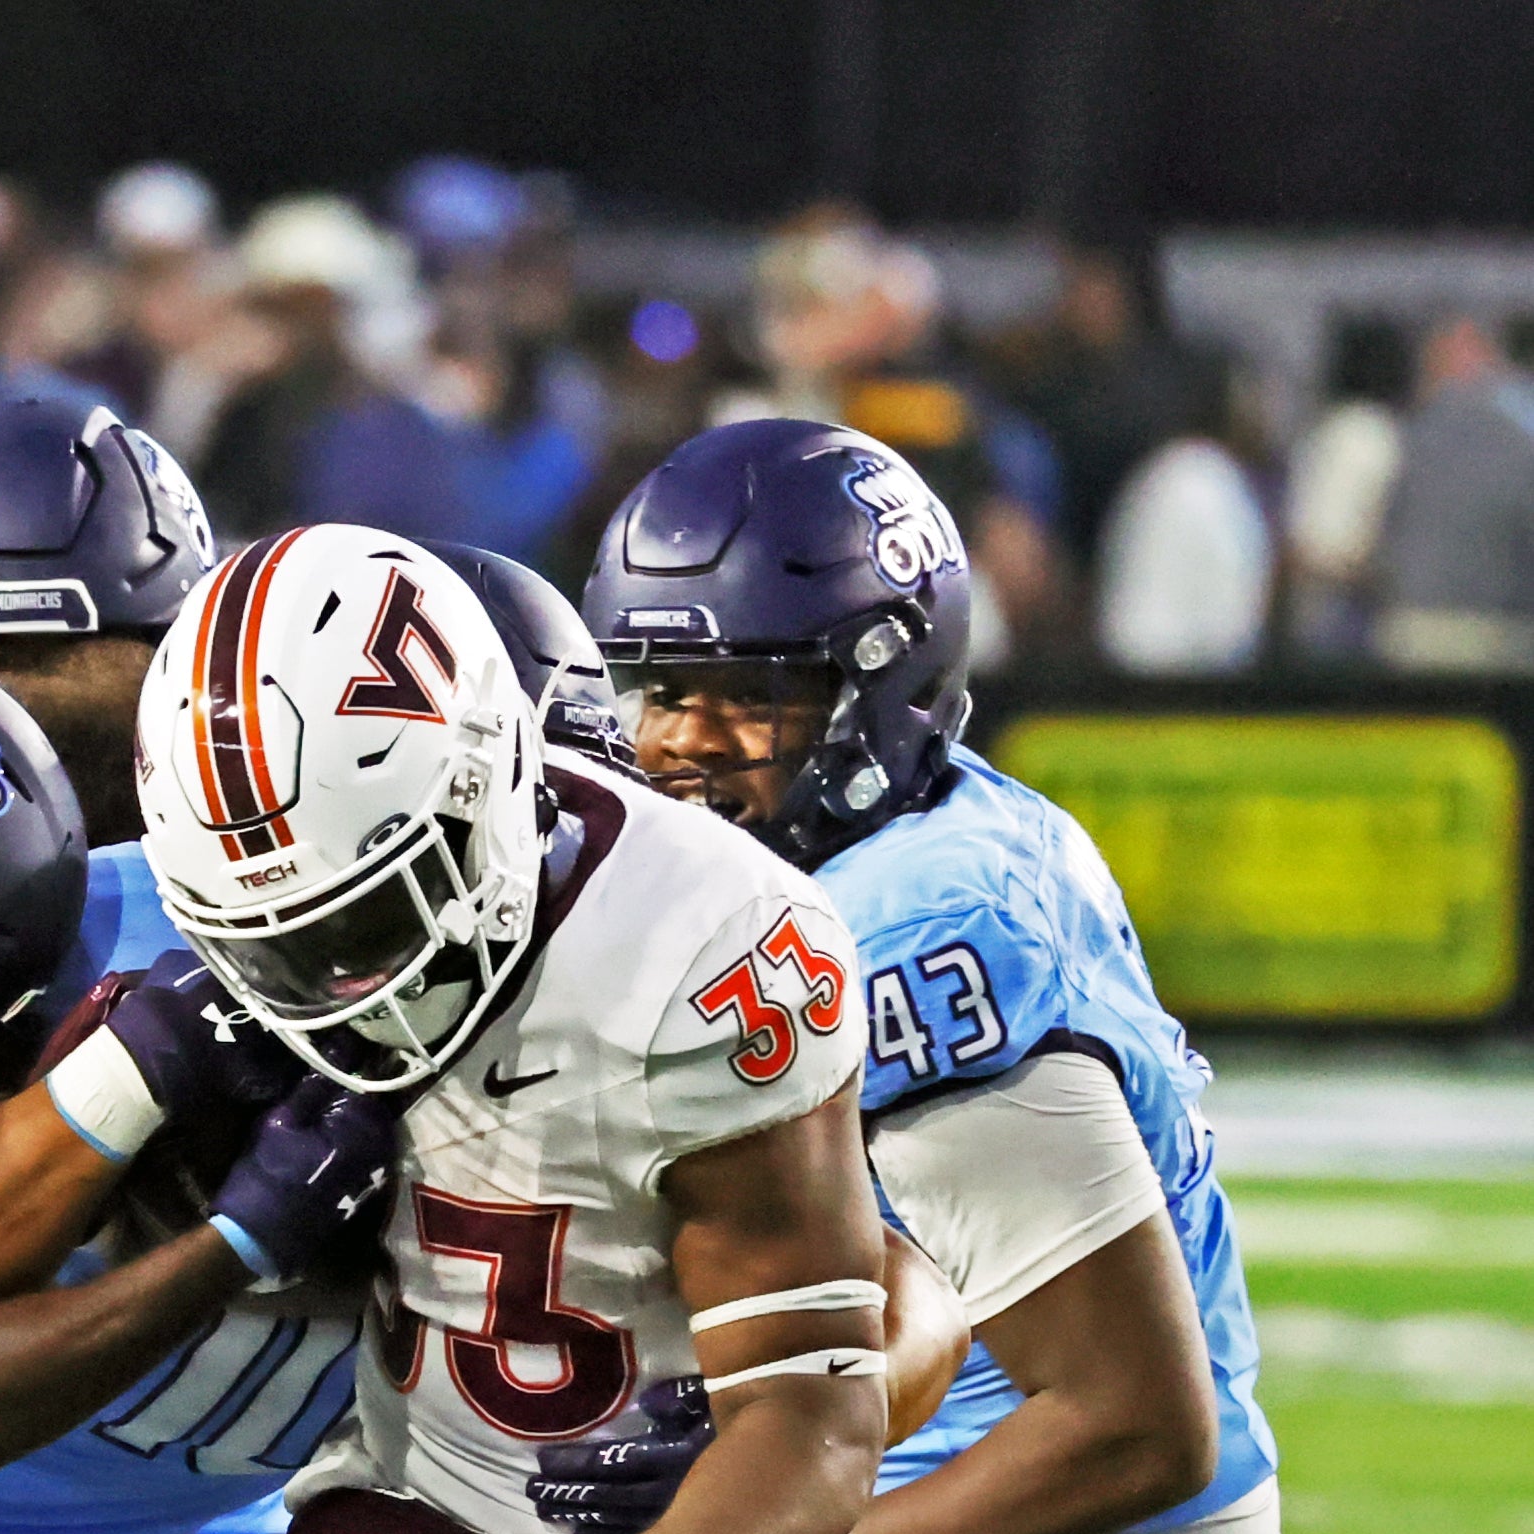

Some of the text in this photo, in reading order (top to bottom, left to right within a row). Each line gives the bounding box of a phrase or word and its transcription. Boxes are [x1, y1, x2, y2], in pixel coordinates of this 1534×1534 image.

[234, 860, 298, 891] TECH
[688, 907, 848, 1086] 33
[868, 941, 1009, 1082] 43
